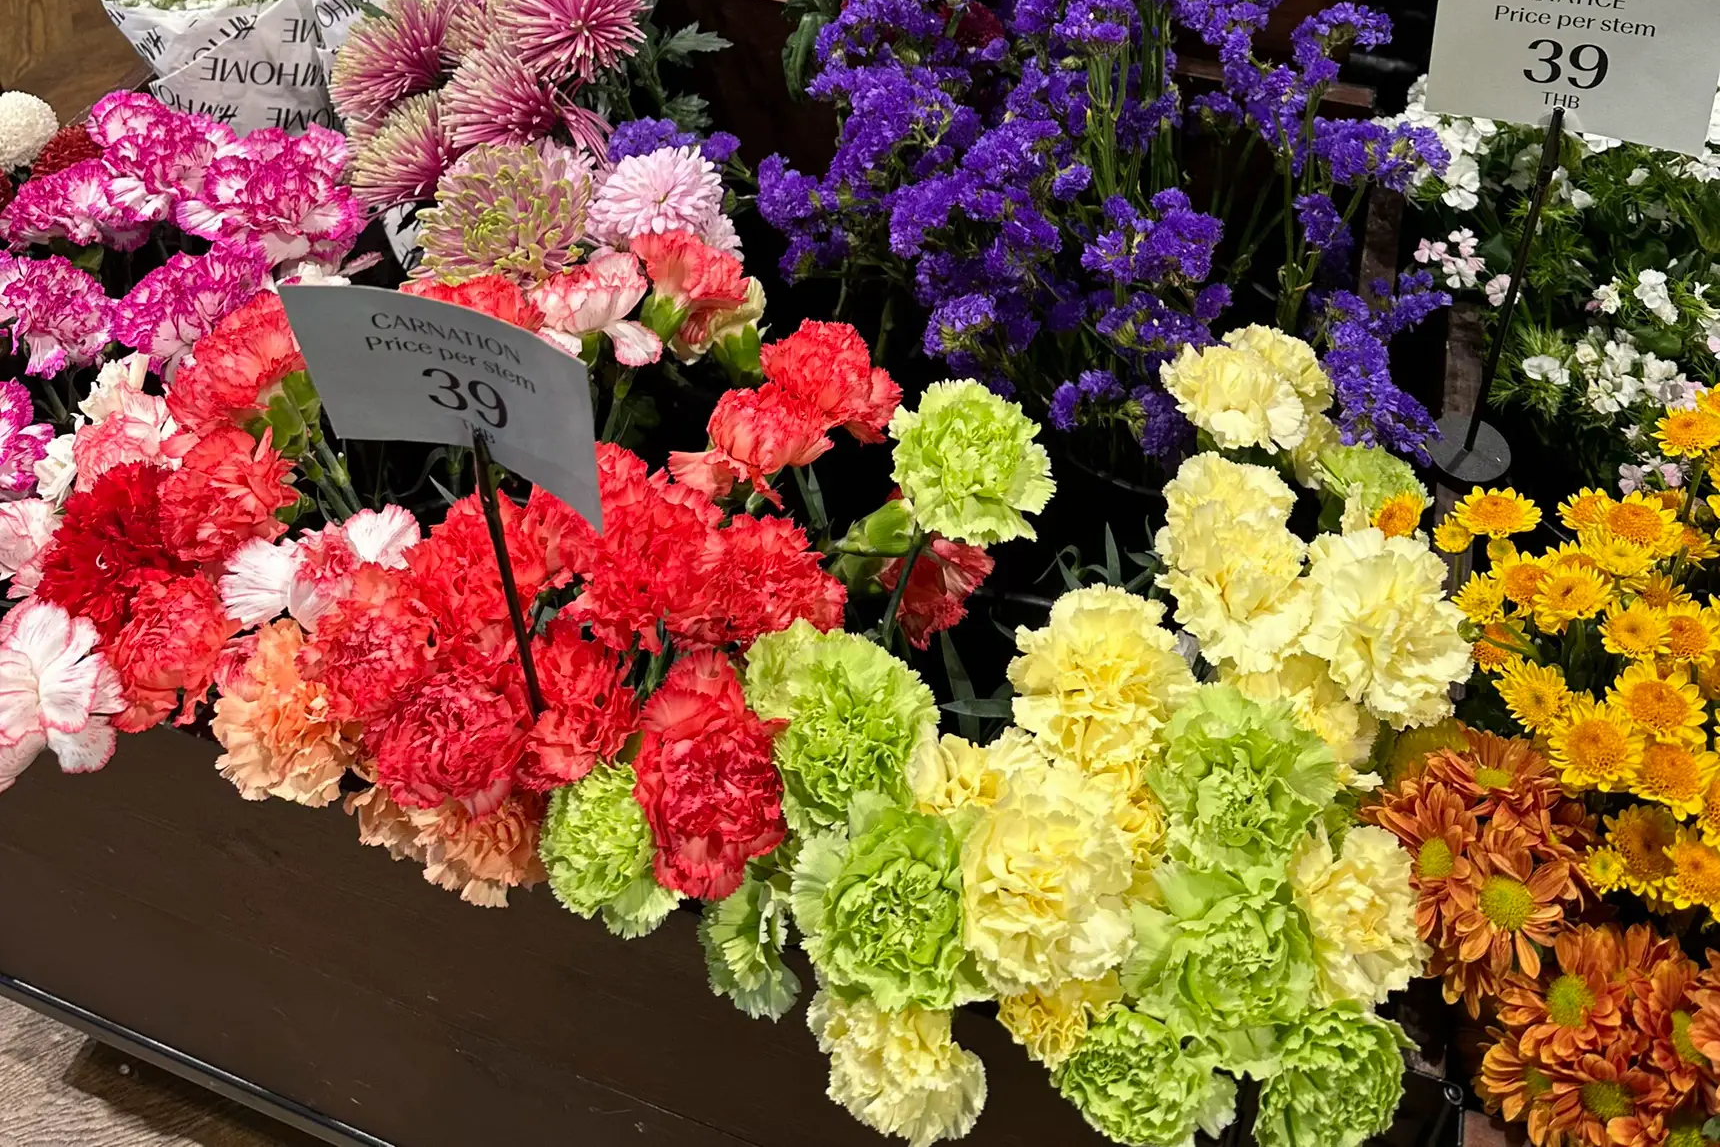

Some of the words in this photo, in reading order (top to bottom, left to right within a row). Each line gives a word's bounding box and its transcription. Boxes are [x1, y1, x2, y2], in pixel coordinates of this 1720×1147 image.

[1494, 5, 1551, 25] Price
[1556, 13, 1596, 30] per
[1600, 17, 1656, 37] stem
[200, 56, 299, 87] HOME
[1522, 39, 1609, 90] 39
[1541, 91, 1580, 110] THB
[371, 312, 522, 365] CARNATION
[365, 335, 433, 355] Price
[438, 347, 477, 367] per
[482, 359, 537, 394] stem
[422, 367, 508, 429] 39
